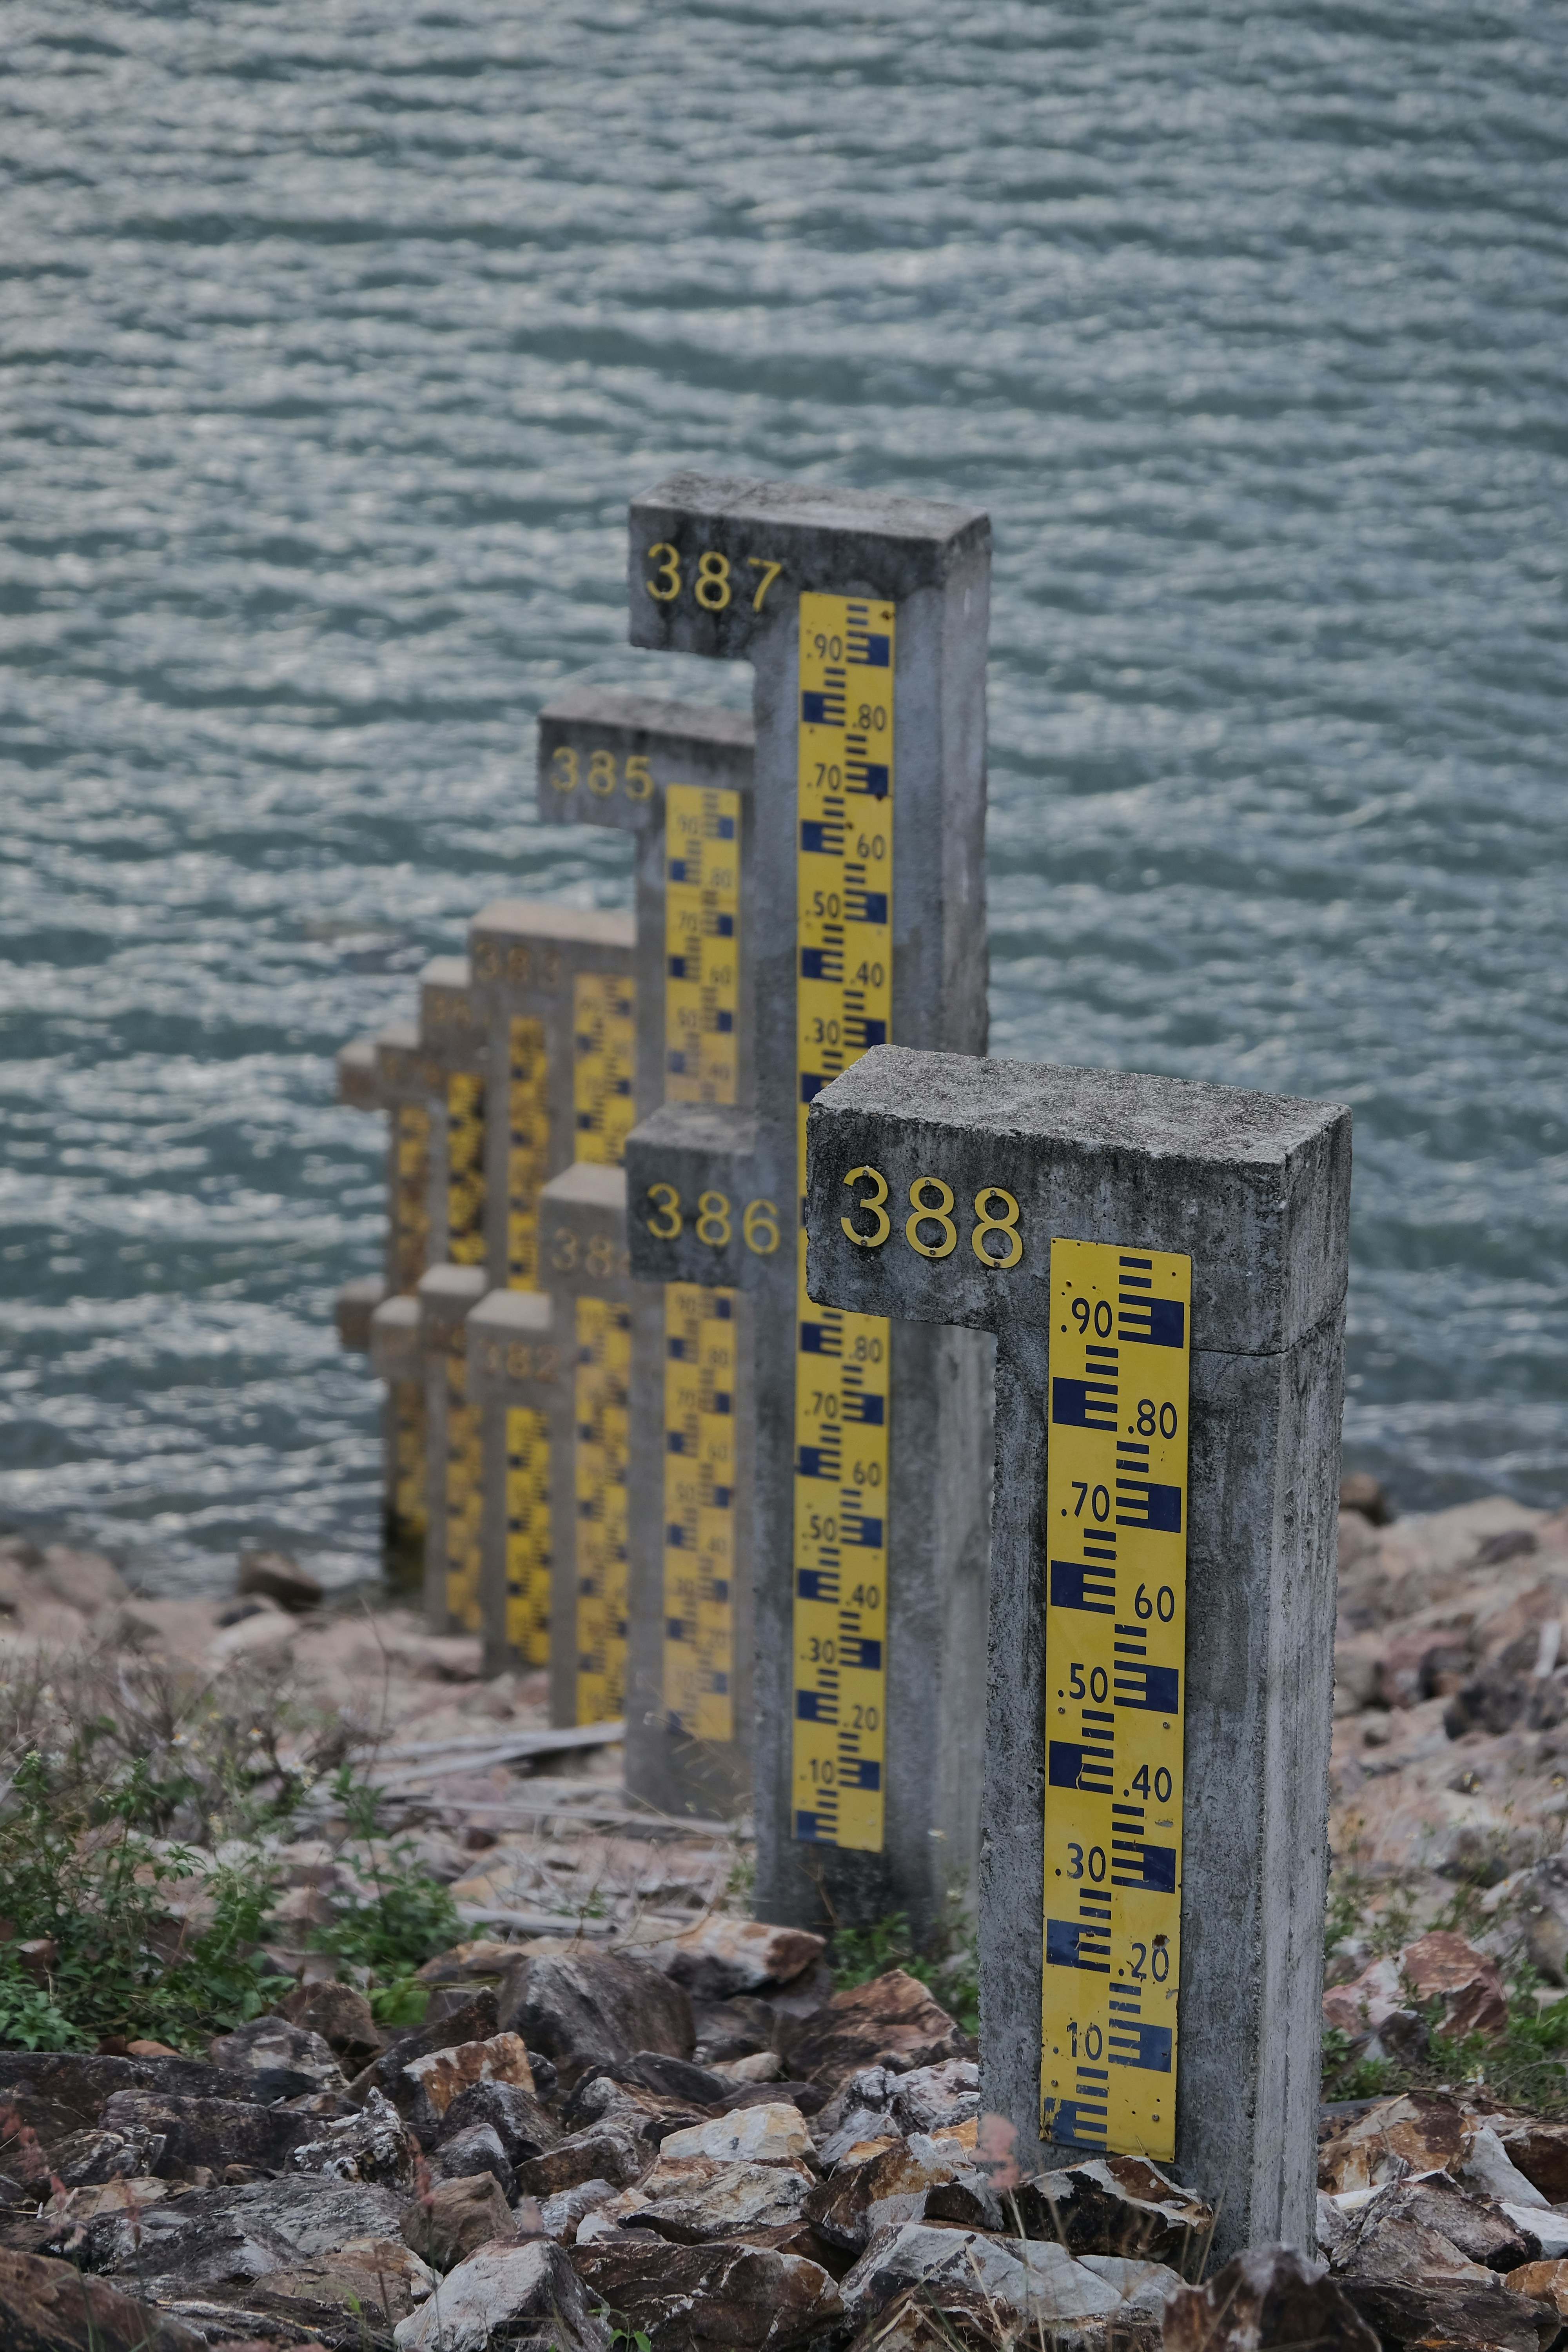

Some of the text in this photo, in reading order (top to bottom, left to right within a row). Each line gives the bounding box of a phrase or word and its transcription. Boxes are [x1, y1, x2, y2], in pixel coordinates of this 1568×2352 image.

[646, 543, 782, 612] 387
[551, 747, 654, 800] 385
[857, 833, 886, 861] 60
[647, 1182, 780, 1254] 386
[841, 1166, 1022, 1269] 388
[1061, 1298, 1112, 1338] .90
[1128, 1399, 1177, 1439] .80
[853, 1460, 882, 1487] 60
[1061, 1481, 1111, 1522] .70
[1134, 1583, 1175, 1622] 60
[1058, 1663, 1108, 1703] .50
[1123, 1764, 1172, 1802] .40
[1055, 1842, 1106, 1882] .30
[1118, 1942, 1169, 1983] .20
[1053, 2022, 1102, 2061] .10
